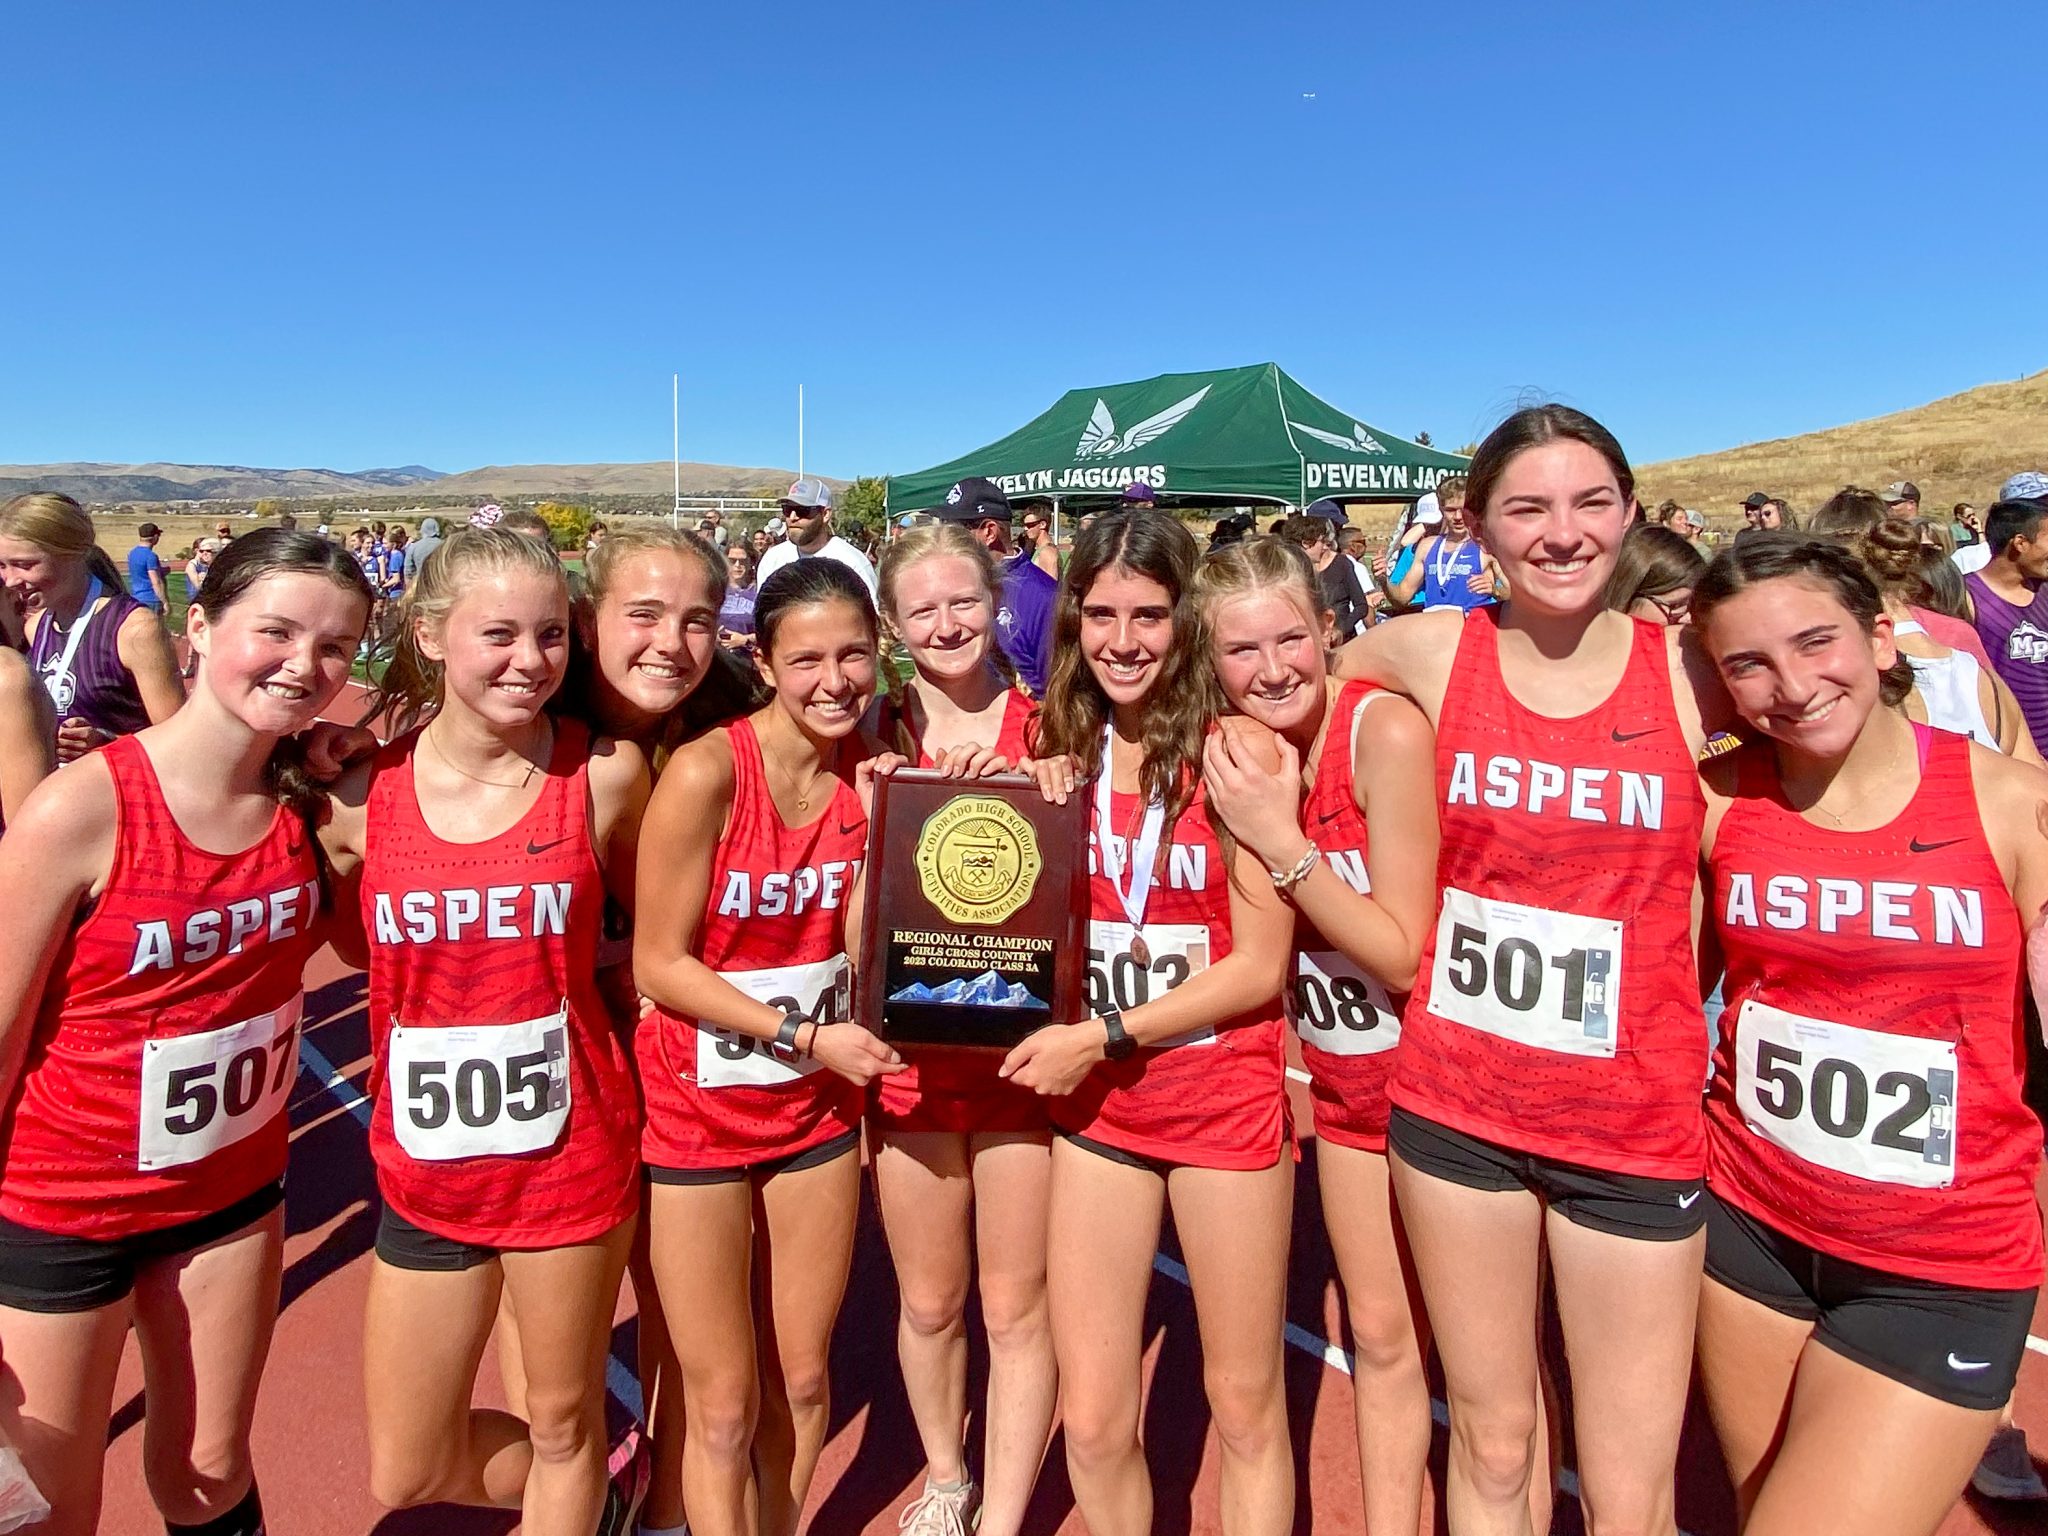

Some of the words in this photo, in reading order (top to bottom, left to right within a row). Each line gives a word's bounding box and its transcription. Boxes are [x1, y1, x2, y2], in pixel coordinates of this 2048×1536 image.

[1057, 465, 1166, 488] JAGUARS
[1306, 463, 1409, 489] D'EVELYN
[1447, 752, 1665, 831] ASPEN
[926, 803, 973, 853] COLORADO
[976, 802, 1006, 818] HIGH
[1006, 814, 1034, 859] SCHOOL
[374, 881, 573, 945] ASPEN
[923, 866, 969, 918] ACTIVITIES
[971, 872, 1034, 920] ASSOCIATION
[1726, 873, 1985, 948] ASPEN
[893, 931, 971, 947] REGIONAL
[973, 935, 1053, 951] CHAMPION
[904, 956, 926, 966] 2023
[928, 958, 988, 969] COLORADO
[990, 961, 1024, 972] CLASS
[1026, 962, 1039, 973] 3A
[911, 946, 944, 957] GIRLS
[945, 949, 980, 959] CROSS
[982, 950, 1034, 962] COUNTRY
[1448, 922, 1588, 1023] 501
[1289, 973, 1379, 1031] 08
[165, 1023, 296, 1135] 507
[407, 1051, 549, 1129] 505
[1756, 1039, 1932, 1154] 502
